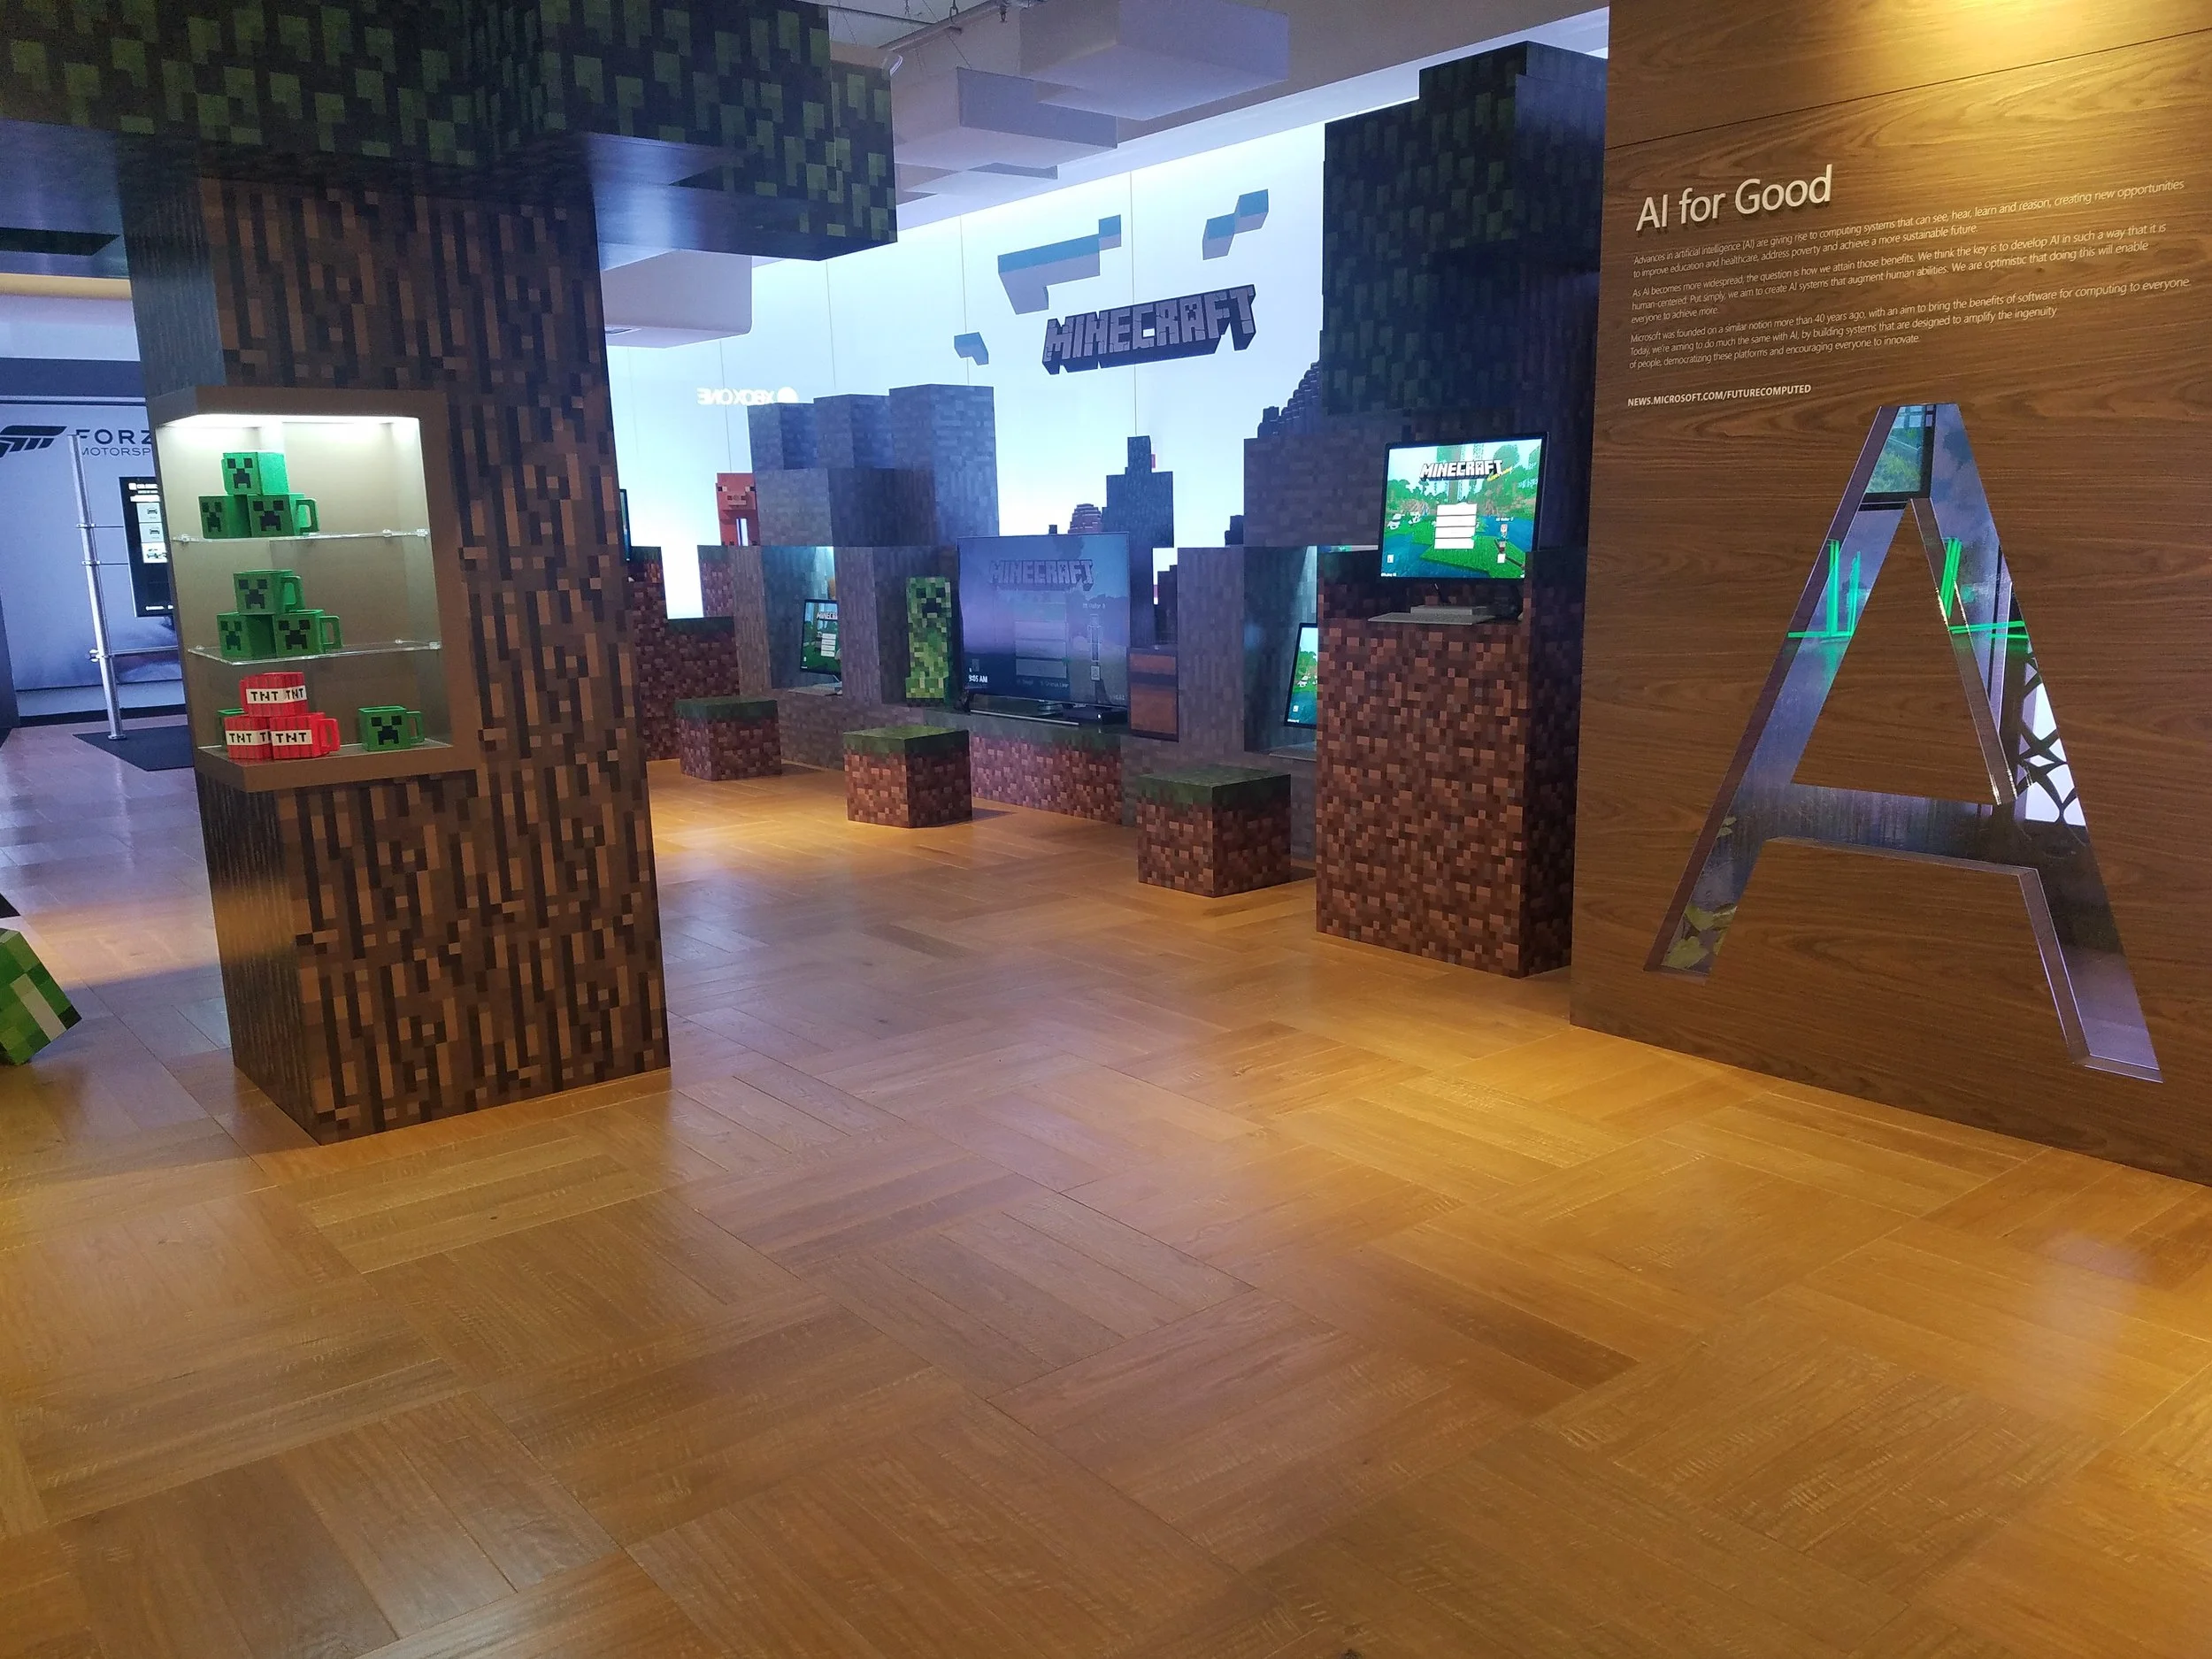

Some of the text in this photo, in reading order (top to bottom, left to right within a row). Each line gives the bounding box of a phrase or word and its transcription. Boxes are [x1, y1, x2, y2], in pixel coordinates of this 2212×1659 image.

[1635, 164, 1833, 232] AI for Good
[1634, 180, 2185, 265] Advances in artificial intelligence (AI) are giving rise to computing systems that can see, hear, learn and reason, creating new opportunities
[1632, 287, 1640, 297] As
[1642, 285, 1650, 296] AI
[1652, 284, 1681, 295] becomes
[1683, 281, 1701, 291] more
[1747, 273, 1758, 283] the
[1761, 268, 1792, 283] question
[1794, 266, 1799, 276] is
[1801, 265, 1817, 275] how
[1820, 265, 1830, 273] we
[1832, 260, 1855, 272] attain
[1857, 257, 1878, 268] those
[1918, 250, 1932, 261] We
[1934, 247, 1955, 259] think
[1957, 245, 1970, 257] the
[1973, 242, 1988, 256] key
[1991, 242, 1996, 252] is
[2000, 242, 2008, 251] to
[2010, 235, 2047, 250] develop
[2049, 234, 2059, 245] AI
[2062, 234, 2070, 243] in
[2073, 230, 2094, 242] such
[2098, 231, 2103, 240] a
[2106, 227, 2124, 239] way
[2128, 225, 2147, 235] that
[2149, 223, 2156, 233] it
[2159, 221, 2166, 232] is
[1633, 269, 1640, 278] to
[1642, 265, 1668, 278] improve
[1671, 260, 1703, 273] education
[1705, 257, 1719, 268] and
[1761, 250, 1789, 260] address
[1792, 242, 1821, 258] poverty
[1823, 241, 1838, 252] and
[1840, 238, 1868, 250] achieve
[1878, 234, 1900, 244] more
[1902, 227, 1947, 242] sustainable
[1690, 294, 1701, 303] Put
[1728, 290, 1738, 299] we
[1740, 288, 1753, 297] aim
[1755, 287, 1763, 296] to
[1764, 283, 1787, 295] create
[1789, 280, 1796, 291] AI
[1799, 279, 1828, 292] systems
[1831, 275, 1846, 286] that
[1847, 271, 1883, 286] augment
[1886, 269, 1914, 280] human
[1951, 261, 1965, 272] We
[1968, 261, 1982, 270] are
[1985, 254, 2026, 270] optimistic
[2029, 252, 2047, 263] that
[2049, 248, 2077, 261] doing
[2079, 246, 2095, 257] this
[2098, 243, 2113, 255] will
[2116, 240, 2148, 253] enable
[1042, 284, 1256, 374] MINECRAFT
[1631, 330, 1661, 342] Microsoft
[1677, 326, 1705, 338] founded
[1724, 322, 1747, 333] similar
[1748, 319, 1771, 331] notion
[1774, 318, 1793, 327] more
[1796, 315, 1812, 325] than
[1815, 312, 1824, 323] 40
[1826, 312, 1847, 325] years
[1849, 309, 1866, 322] ago,
[1868, 306, 1885, 318] with
[1900, 304, 1915, 315] aim
[1917, 303, 1926, 312] to
[1929, 299, 1951, 312] bring
[1953, 298, 1967, 309] the
[1969, 295, 2004, 307] benefits
[2007, 293, 2016, 303] of
[2018, 291, 2056, 303] software
[2060, 288, 2073, 299] for
[2075, 282, 2126, 297] computing
[2130, 282, 2139, 291] to
[1631, 308, 1697, 325] everyone to achieve
[1695, 303, 2057, 349] to do much the same with AI, by building systems that are designed to amplify the ingenuity
[1629, 337, 1882, 368] of democratizing these platforms and encouraging everyone to
[1628, 383, 1811, 406] NEWS.MICROSOFT.COM/FUTURECOMPUTED
[1419, 459, 1503, 480] MINECRAFT
[988, 559, 1094, 590] MINECRAFT
[250, 688, 303, 701] TNT TNT
[229, 733, 252, 743] TNT
[276, 733, 306, 742] TNT
